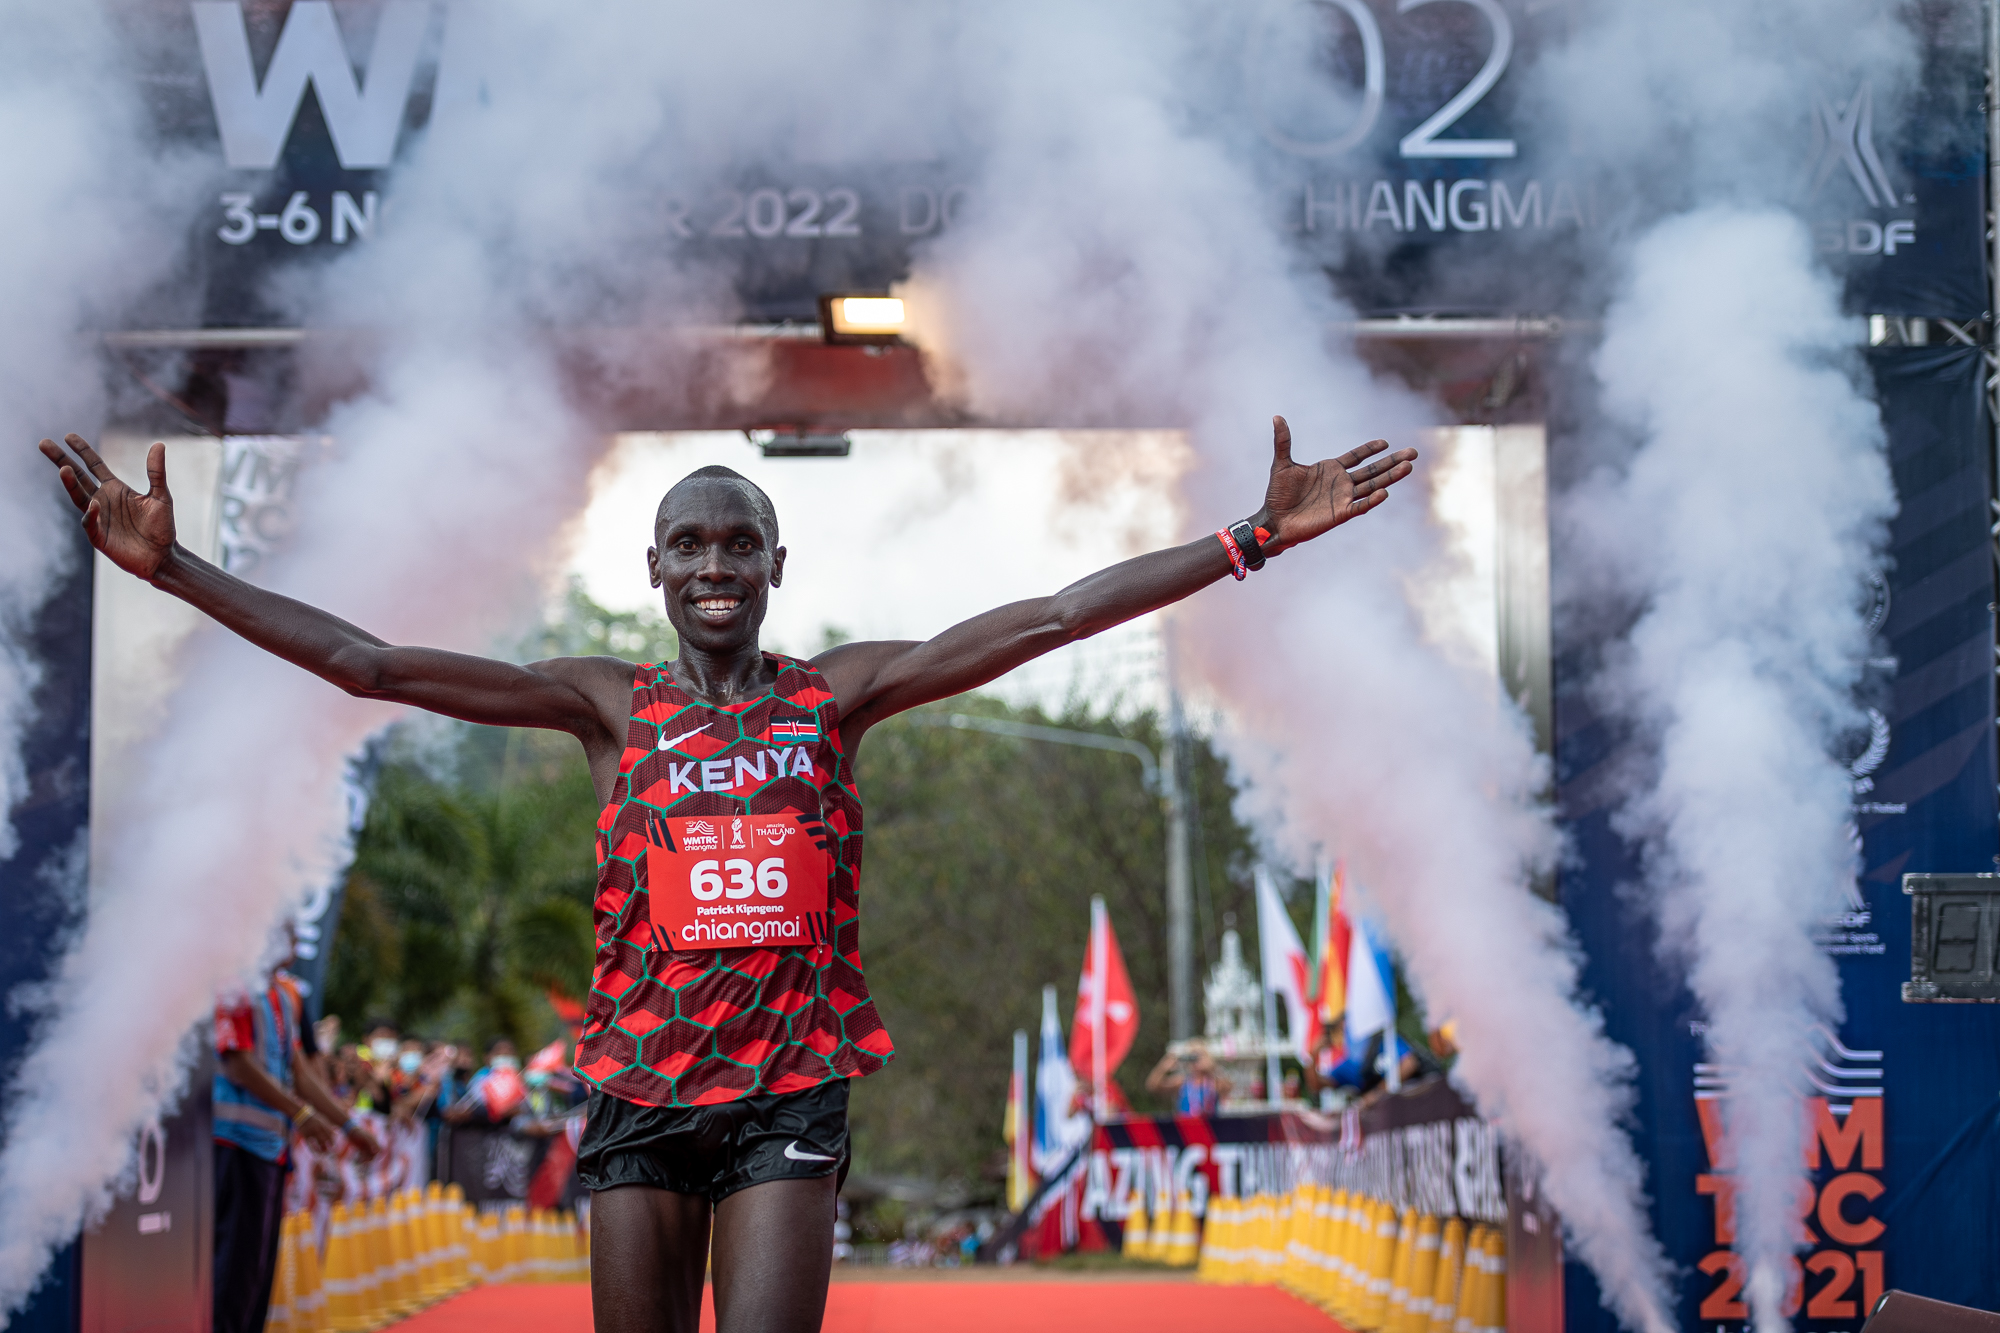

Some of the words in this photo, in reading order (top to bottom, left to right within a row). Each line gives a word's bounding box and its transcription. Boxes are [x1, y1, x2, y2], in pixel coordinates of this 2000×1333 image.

[217, 190, 321, 245] 3-6
[708, 186, 863, 239] 2022
[668, 746, 815, 794] KENYA
[683, 836, 719, 846] WMTRC
[756, 828, 796, 836] THAILAND
[684, 844, 717, 852] chiangmai
[690, 857, 788, 901] 636
[697, 905, 734, 916] Patrick
[735, 904, 785, 916] Kipngeno
[681, 916, 800, 945] chiangmai
